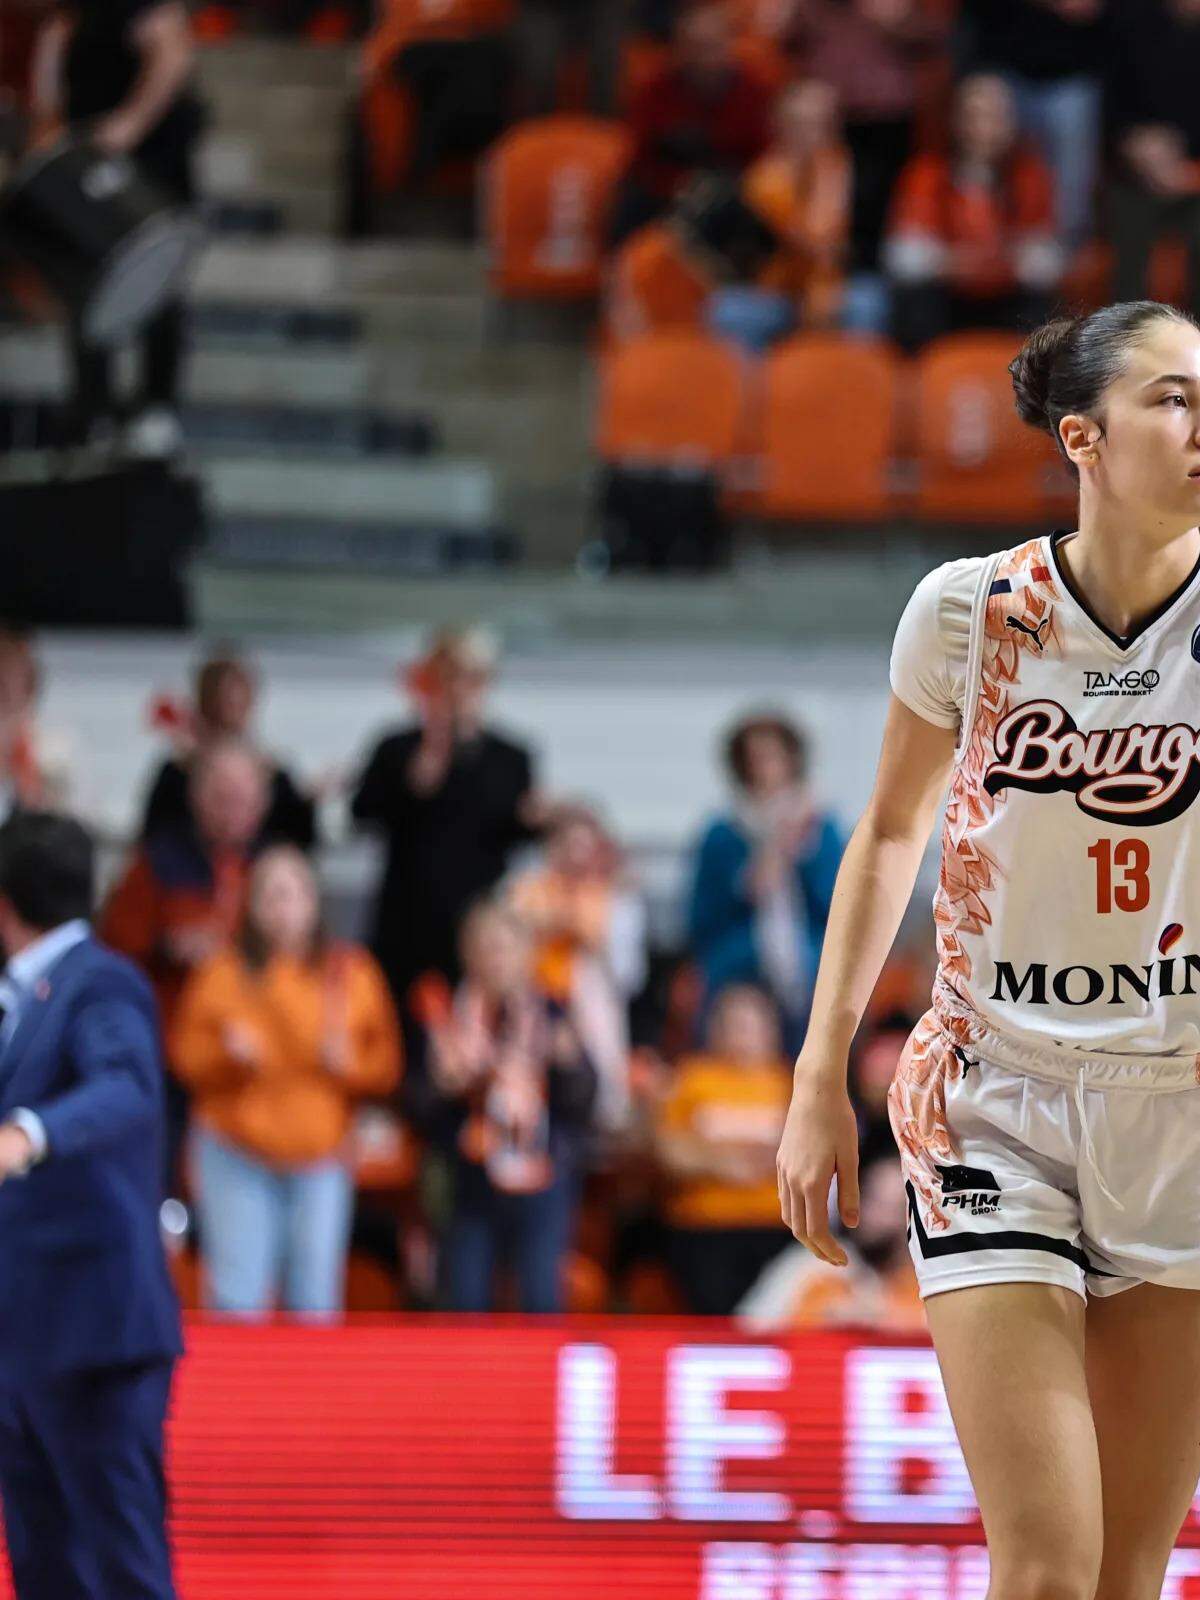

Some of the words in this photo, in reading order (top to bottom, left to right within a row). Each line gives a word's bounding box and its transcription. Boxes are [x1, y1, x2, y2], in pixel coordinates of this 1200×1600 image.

[1083, 669, 1160, 690] TANGO
[1083, 690, 1120, 698] BOURGES
[1121, 689, 1154, 697] BASKET
[1088, 838, 1151, 914] 13
[942, 1193, 1001, 1209] PHM
[555, 1342, 794, 1522] LE
